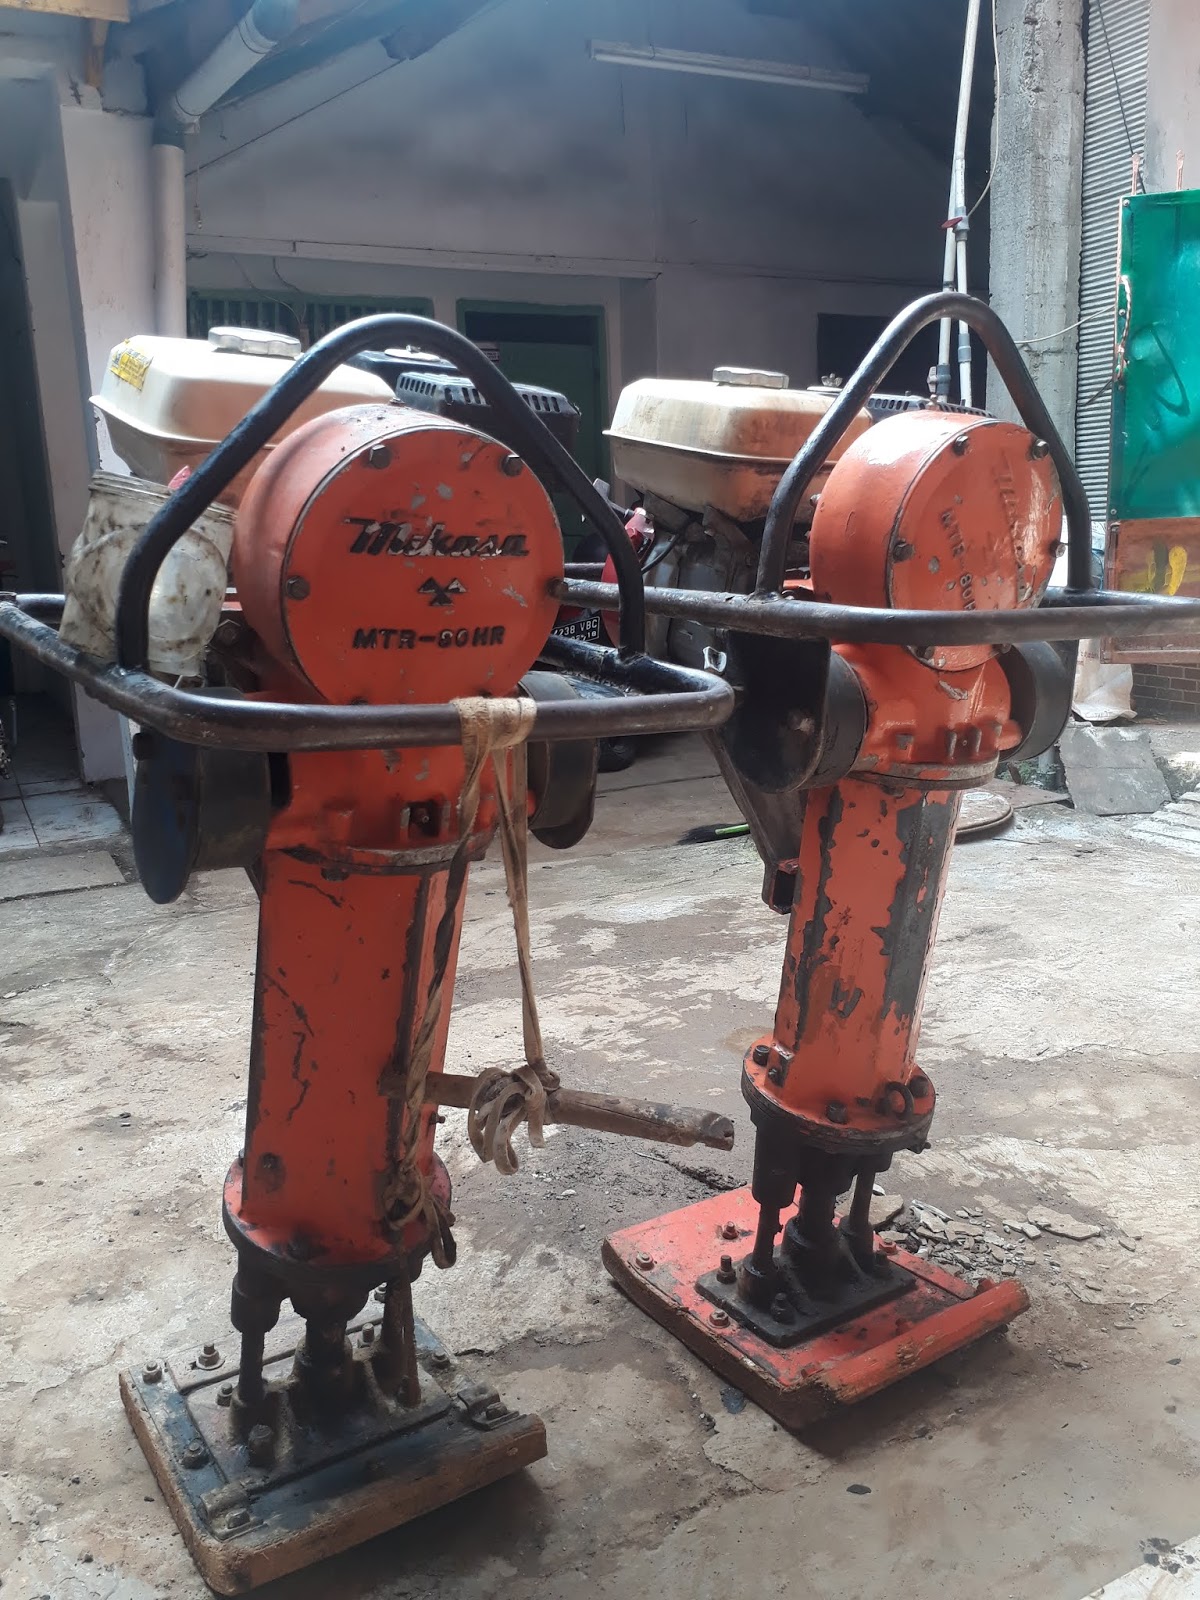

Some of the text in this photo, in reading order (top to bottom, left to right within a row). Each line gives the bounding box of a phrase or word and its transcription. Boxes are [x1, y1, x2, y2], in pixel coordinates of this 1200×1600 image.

[343, 517, 529, 557] Mikasa
[352, 625, 506, 650] MTR-80HR
[580, 619, 597, 631] VBC
